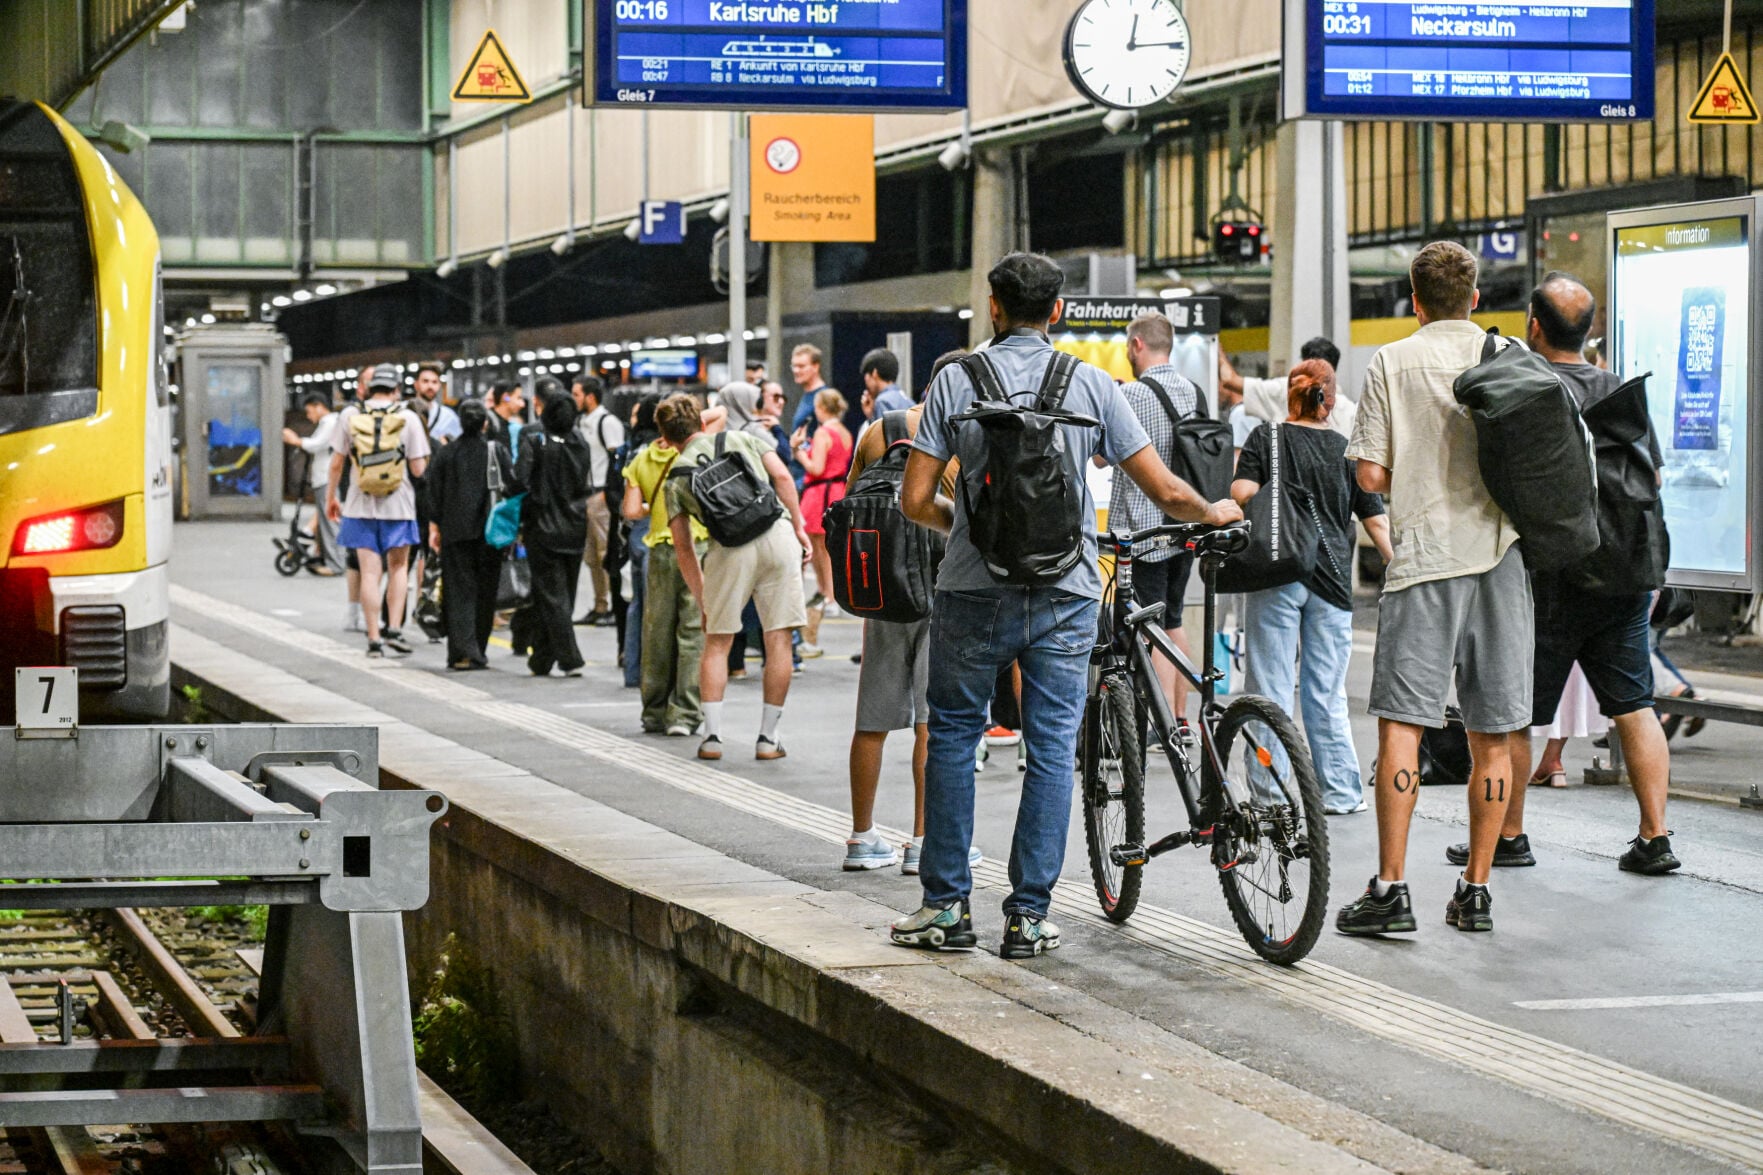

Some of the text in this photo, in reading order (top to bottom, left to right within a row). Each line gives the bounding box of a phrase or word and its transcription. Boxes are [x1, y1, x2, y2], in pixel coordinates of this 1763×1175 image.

[616, 1, 668, 20] 00:16
[709, 2, 838, 24] Karlsruhe Hbf
[1324, 3, 1344, 13] MEX
[1411, 4, 1468, 16] Ludwigsburg
[1476, 6, 1520, 17] Bietigheim
[1529, 6, 1571, 17] Heilbronn
[1572, 8, 1588, 18] Hbf
[1324, 14, 1371, 34] 00:31
[1411, 16, 1516, 37] Neckarsulm
[642, 59, 668, 69] 00:21
[726, 61, 732, 71] 1
[739, 61, 778, 71] Ankunft
[780, 63, 798, 72] von
[800, 62, 847, 73] Karlsruhe
[848, 63, 865, 73] Hbf
[642, 71, 669, 82] 00:47
[739, 72, 794, 84] Neckarsulm
[801, 75, 815, 85] via
[818, 75, 877, 87] Ludwigsburg
[1412, 73, 1431, 83] MEX
[1451, 74, 1494, 84] Heilbronn
[1495, 74, 1510, 84] Hbf
[1517, 76, 1531, 85] via
[1533, 75, 1589, 87] Ludwigsburg
[617, 89, 655, 102] Gleis 7
[1347, 83, 1373, 94] 01:12
[1412, 84, 1590, 98] MEX 17 Pforzheim Hbf via Ludwigsburg
[1600, 104, 1636, 117] Gleis 8
[763, 192, 861, 204] Raucherbereich
[644, 202, 666, 235] F
[774, 211, 851, 222] Smoking Area
[1491, 221, 1516, 254] G
[1665, 224, 1710, 245] Information
[1272, 518, 1279, 527] DO
[1271, 534, 1279, 549] NOW
[38, 676, 55, 714] 7
[1484, 777, 1505, 803] 11
